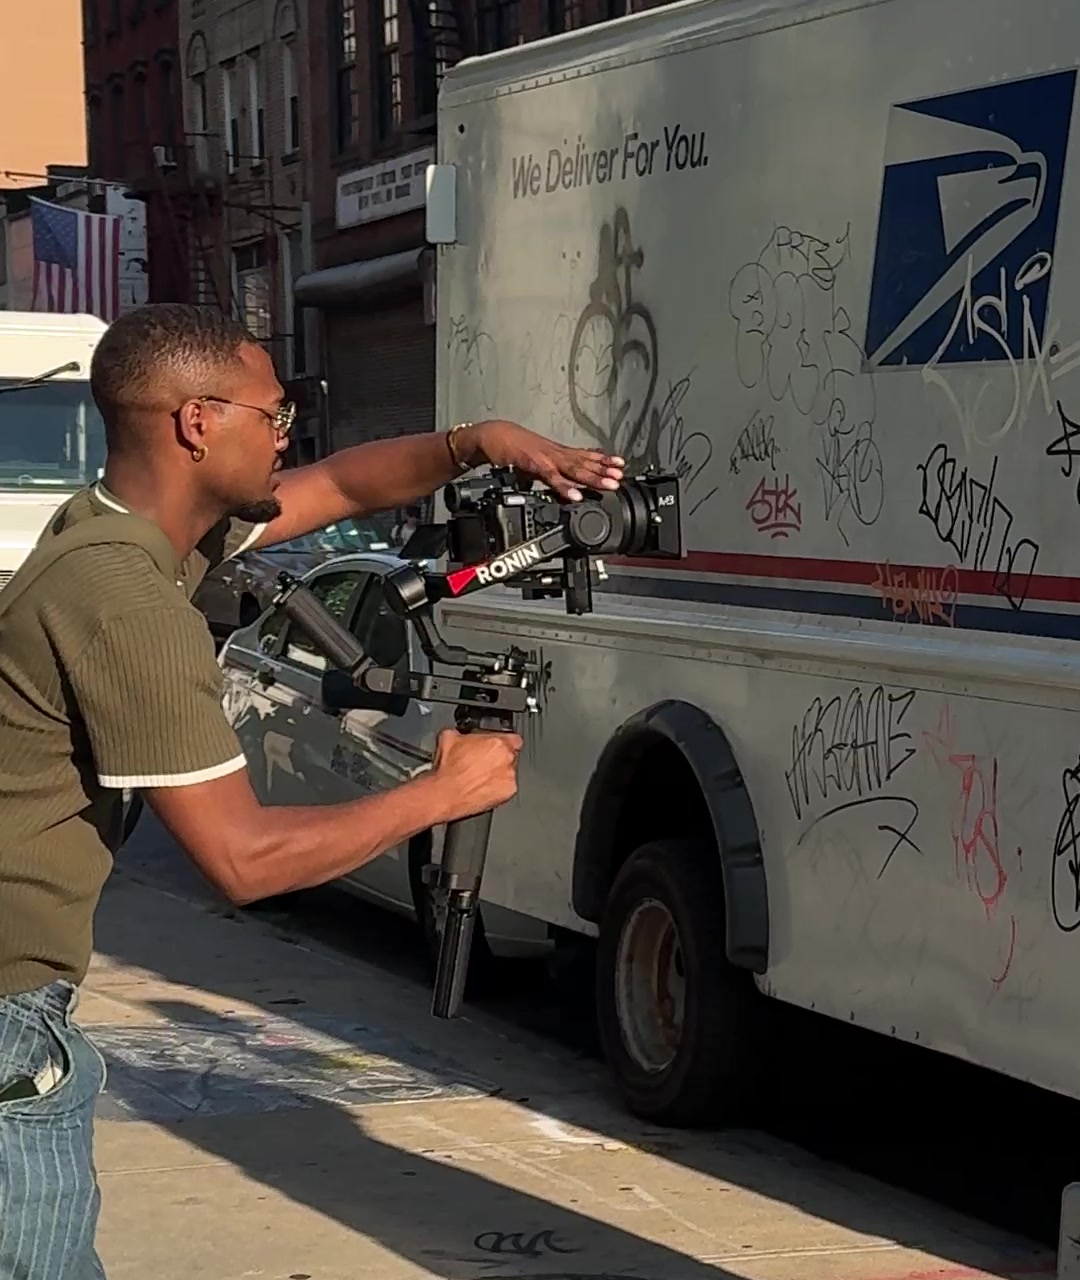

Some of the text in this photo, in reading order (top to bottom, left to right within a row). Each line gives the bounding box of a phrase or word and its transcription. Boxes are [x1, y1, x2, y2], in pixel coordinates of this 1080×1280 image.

[512, 124, 709, 199] We Deliver For You.
[475, 543, 541, 584] RONIN
